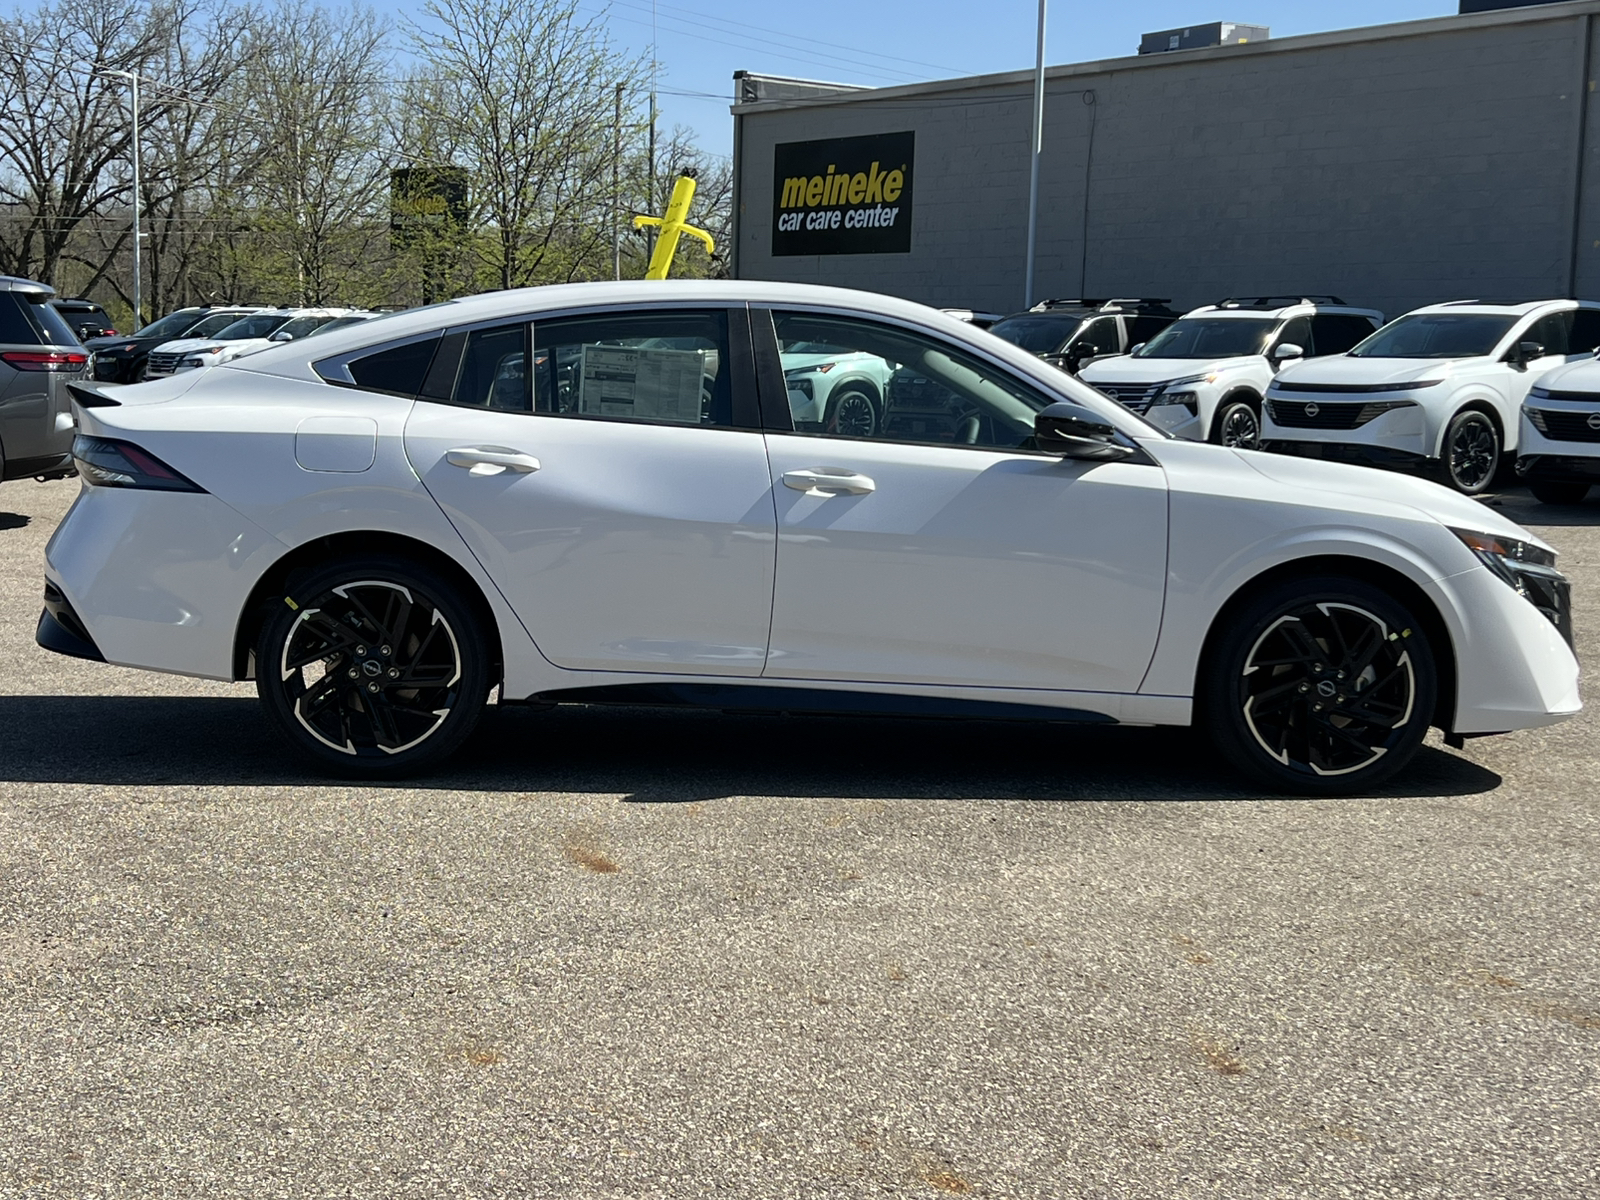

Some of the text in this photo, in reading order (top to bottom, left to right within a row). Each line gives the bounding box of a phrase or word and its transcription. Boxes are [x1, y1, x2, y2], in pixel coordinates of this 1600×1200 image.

[780, 161, 904, 208] meineke
[778, 203, 899, 231] car care center
